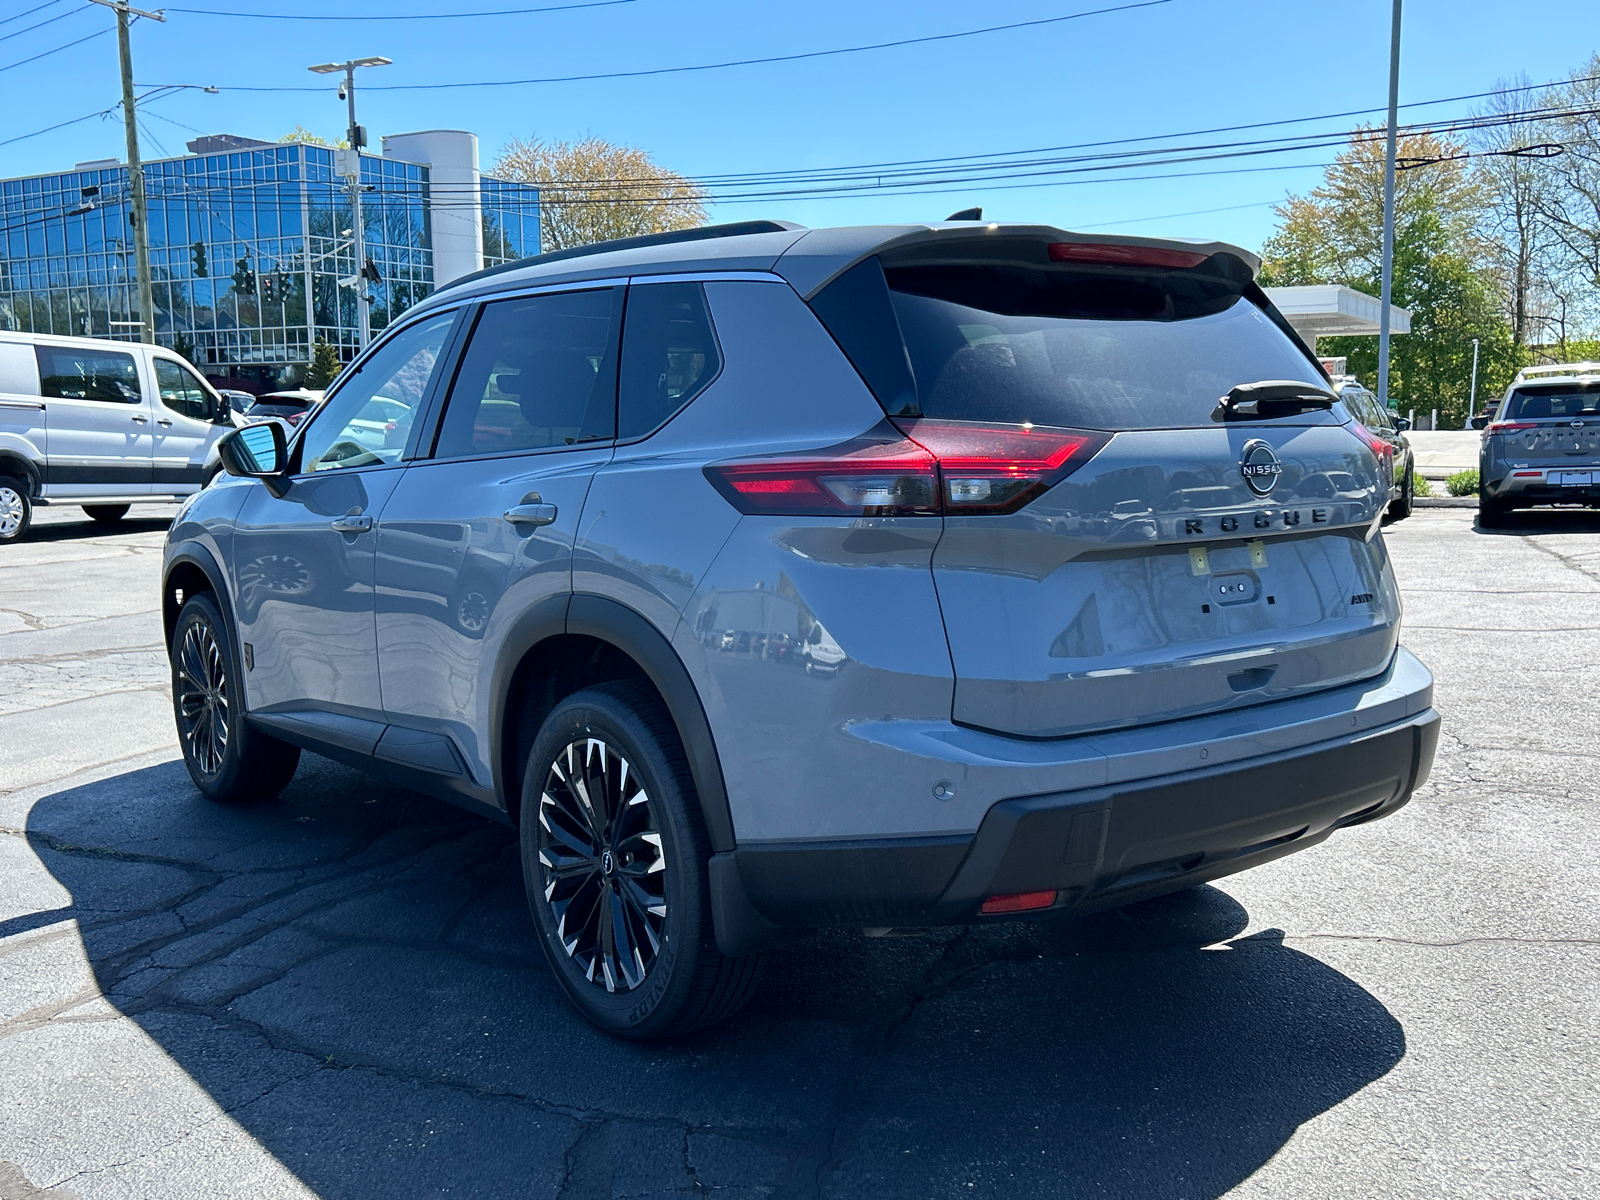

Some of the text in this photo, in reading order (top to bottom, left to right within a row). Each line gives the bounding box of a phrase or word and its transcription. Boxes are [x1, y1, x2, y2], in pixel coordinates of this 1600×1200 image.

[1243, 464, 1281, 475] NISSAN
[1185, 508, 1327, 535] ROGUE
[1351, 592, 1374, 605] AWD
[628, 951, 677, 1023] DUNLOP
